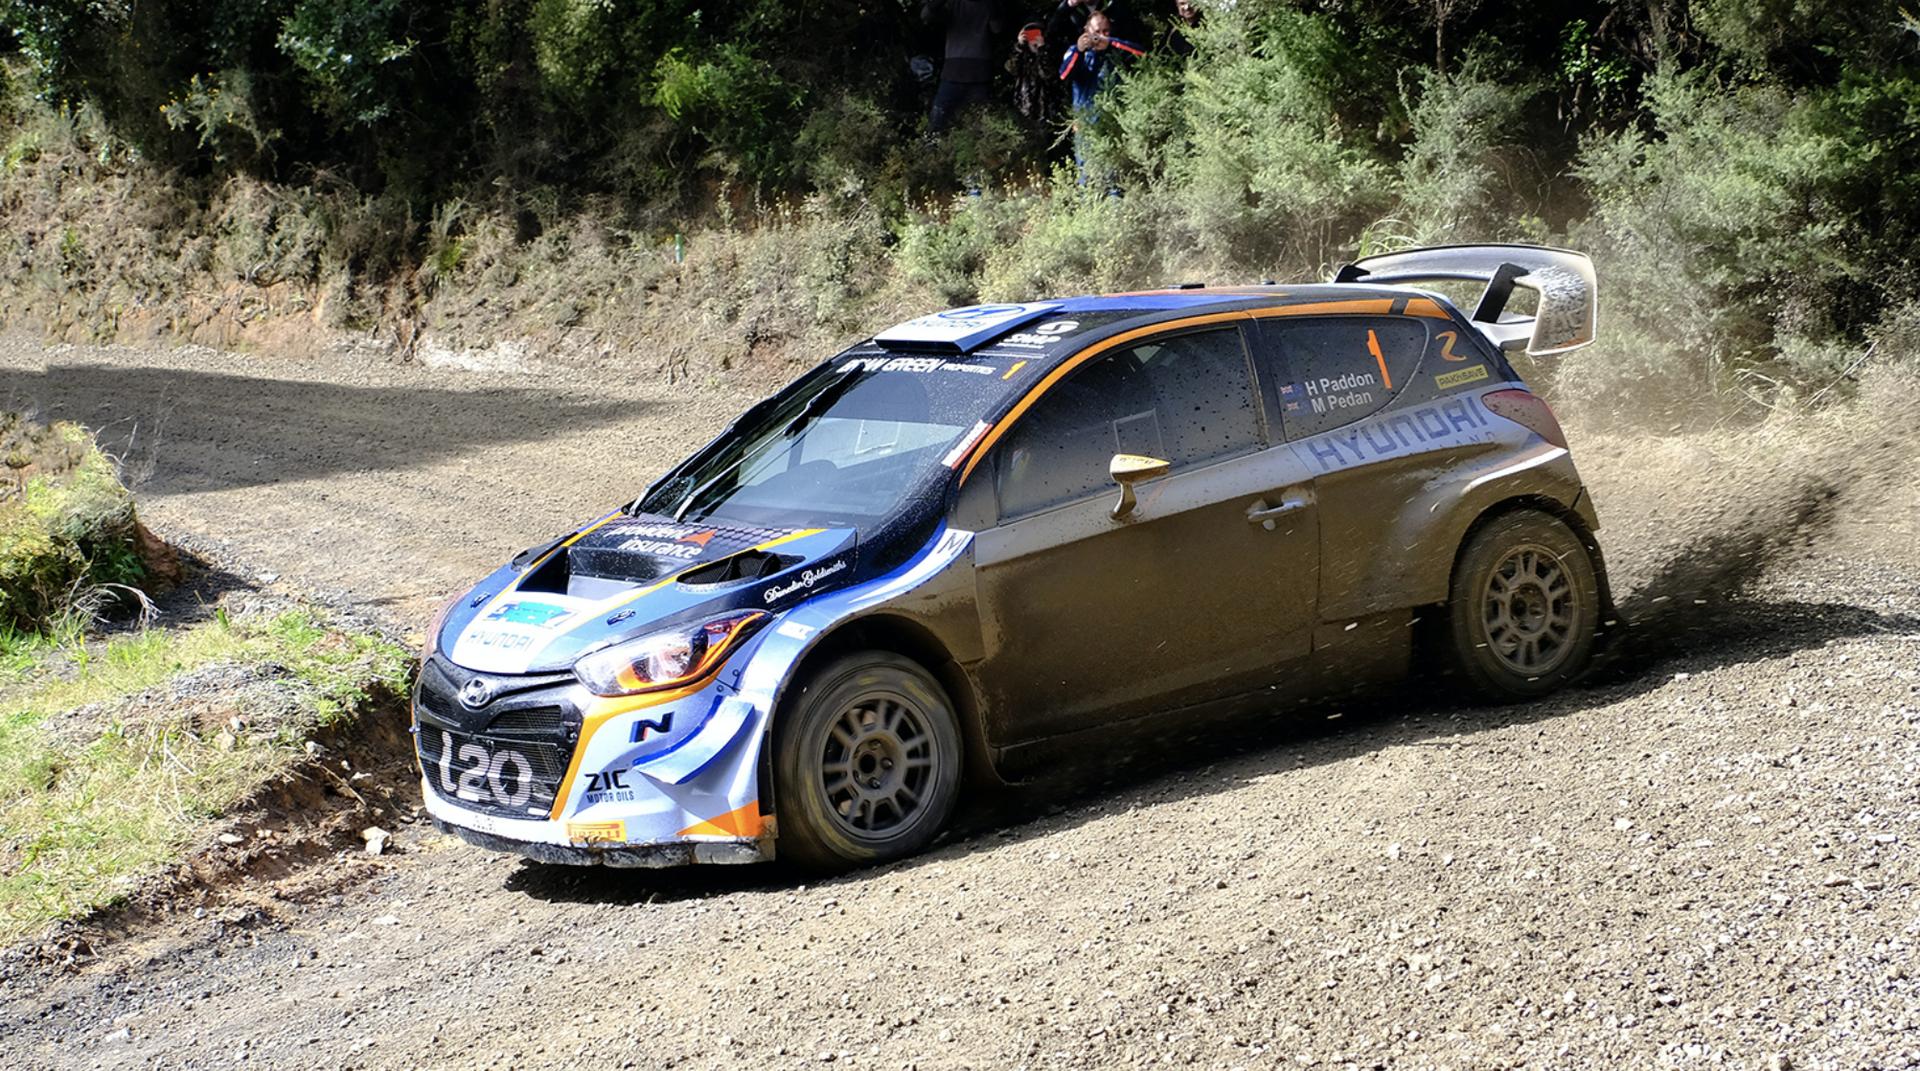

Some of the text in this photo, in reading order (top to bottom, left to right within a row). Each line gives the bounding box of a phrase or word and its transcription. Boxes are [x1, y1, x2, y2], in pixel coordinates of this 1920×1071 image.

[881, 357, 947, 373] GREEN
[1002, 360, 1027, 380] 1
[1366, 329, 1392, 389] 1
[1305, 372, 1375, 396] H Paddon
[1310, 391, 1373, 413] M Pedan
[1307, 396, 1488, 471] HYUNDAI
[617, 536, 703, 559] insurance
[465, 631, 535, 652] HYUNDAI
[628, 710, 676, 743] N
[584, 768, 631, 792] ZIC
[586, 790, 635, 804] MOTOR OILS
